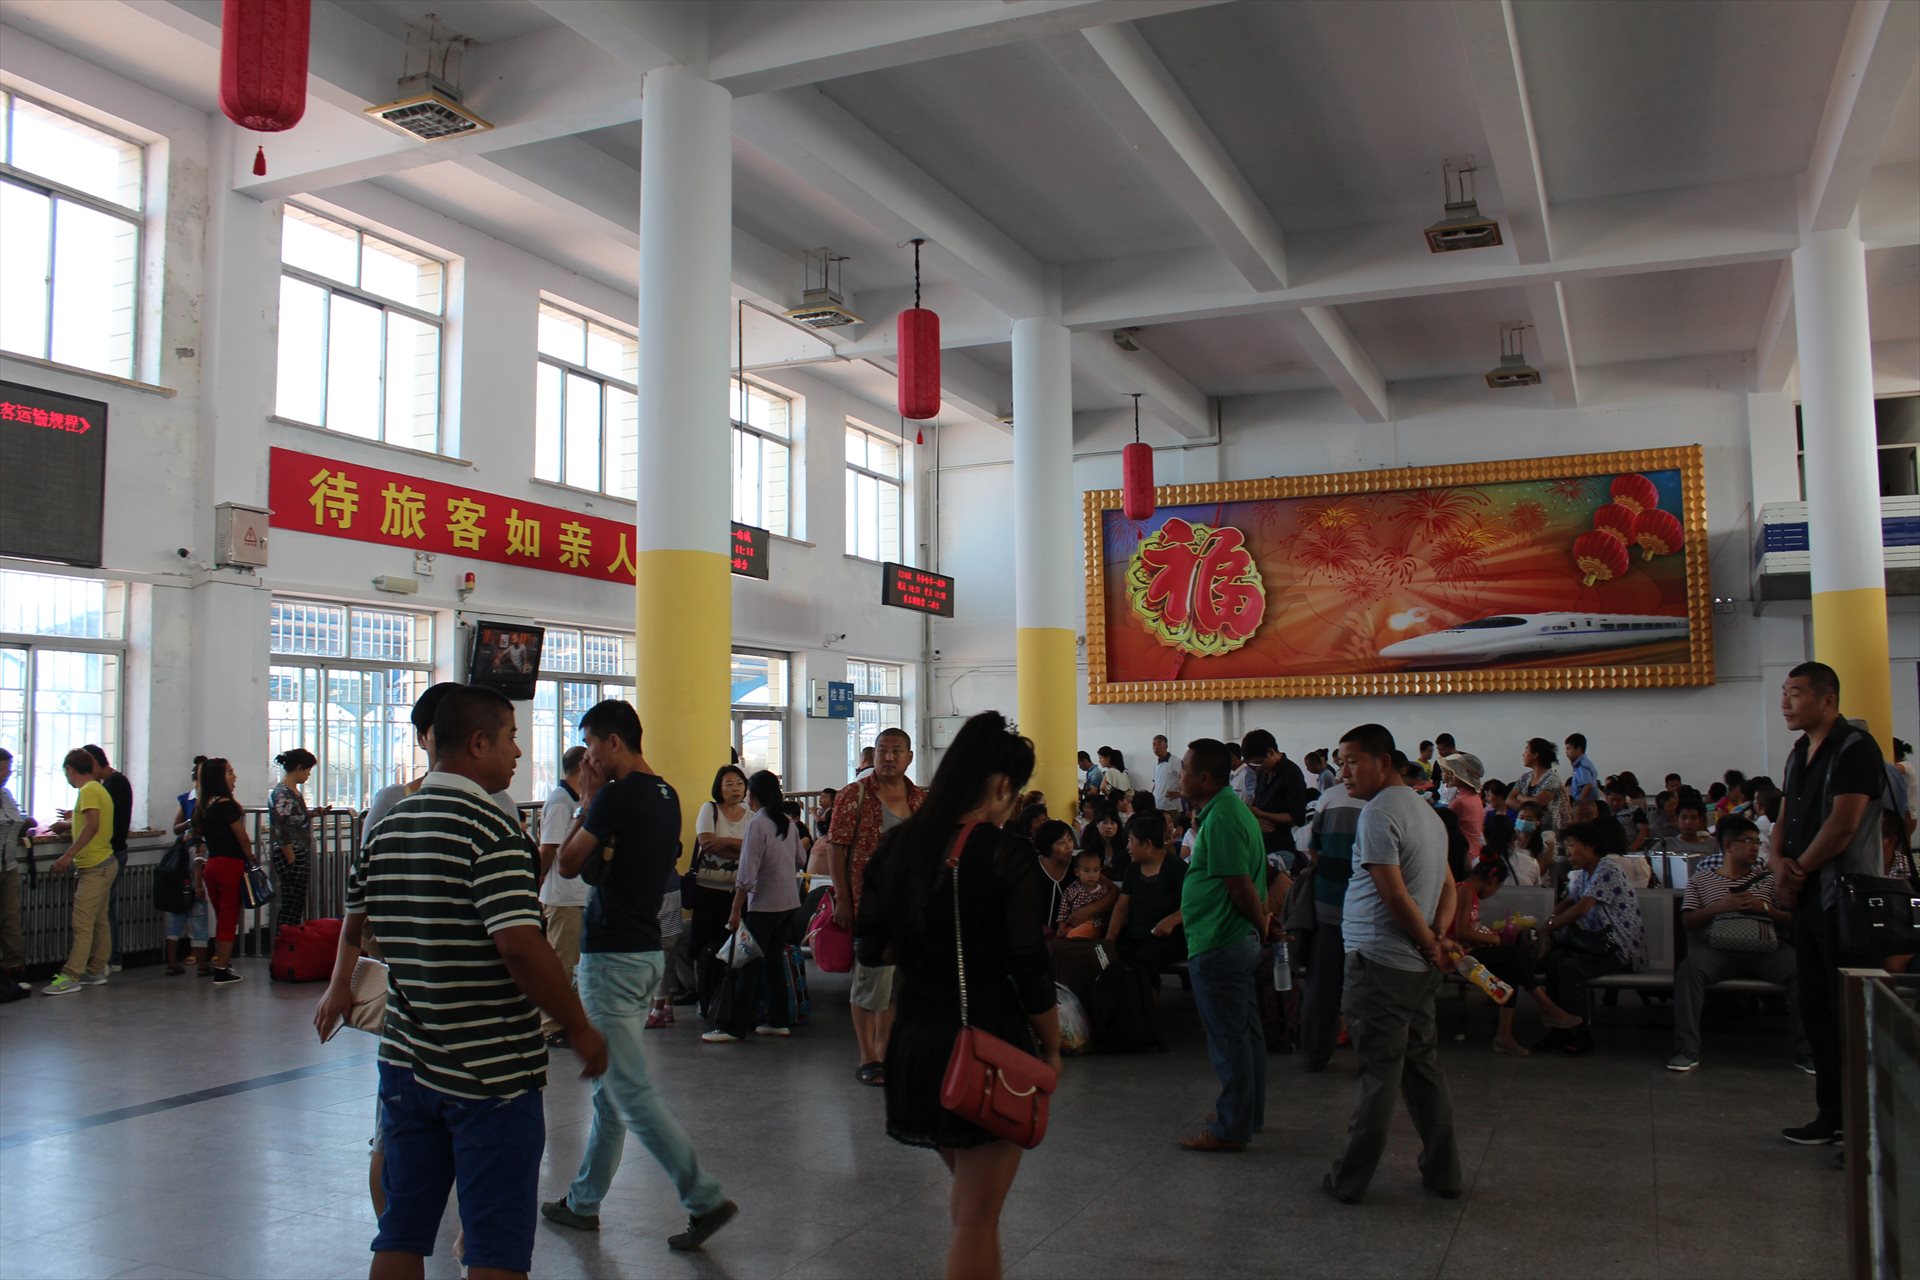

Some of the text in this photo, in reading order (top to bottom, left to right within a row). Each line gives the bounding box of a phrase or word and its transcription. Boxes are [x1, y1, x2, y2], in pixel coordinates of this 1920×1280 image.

[308, 468, 636, 577] 待旅客如亲人
[1141, 516, 1266, 637] 福
